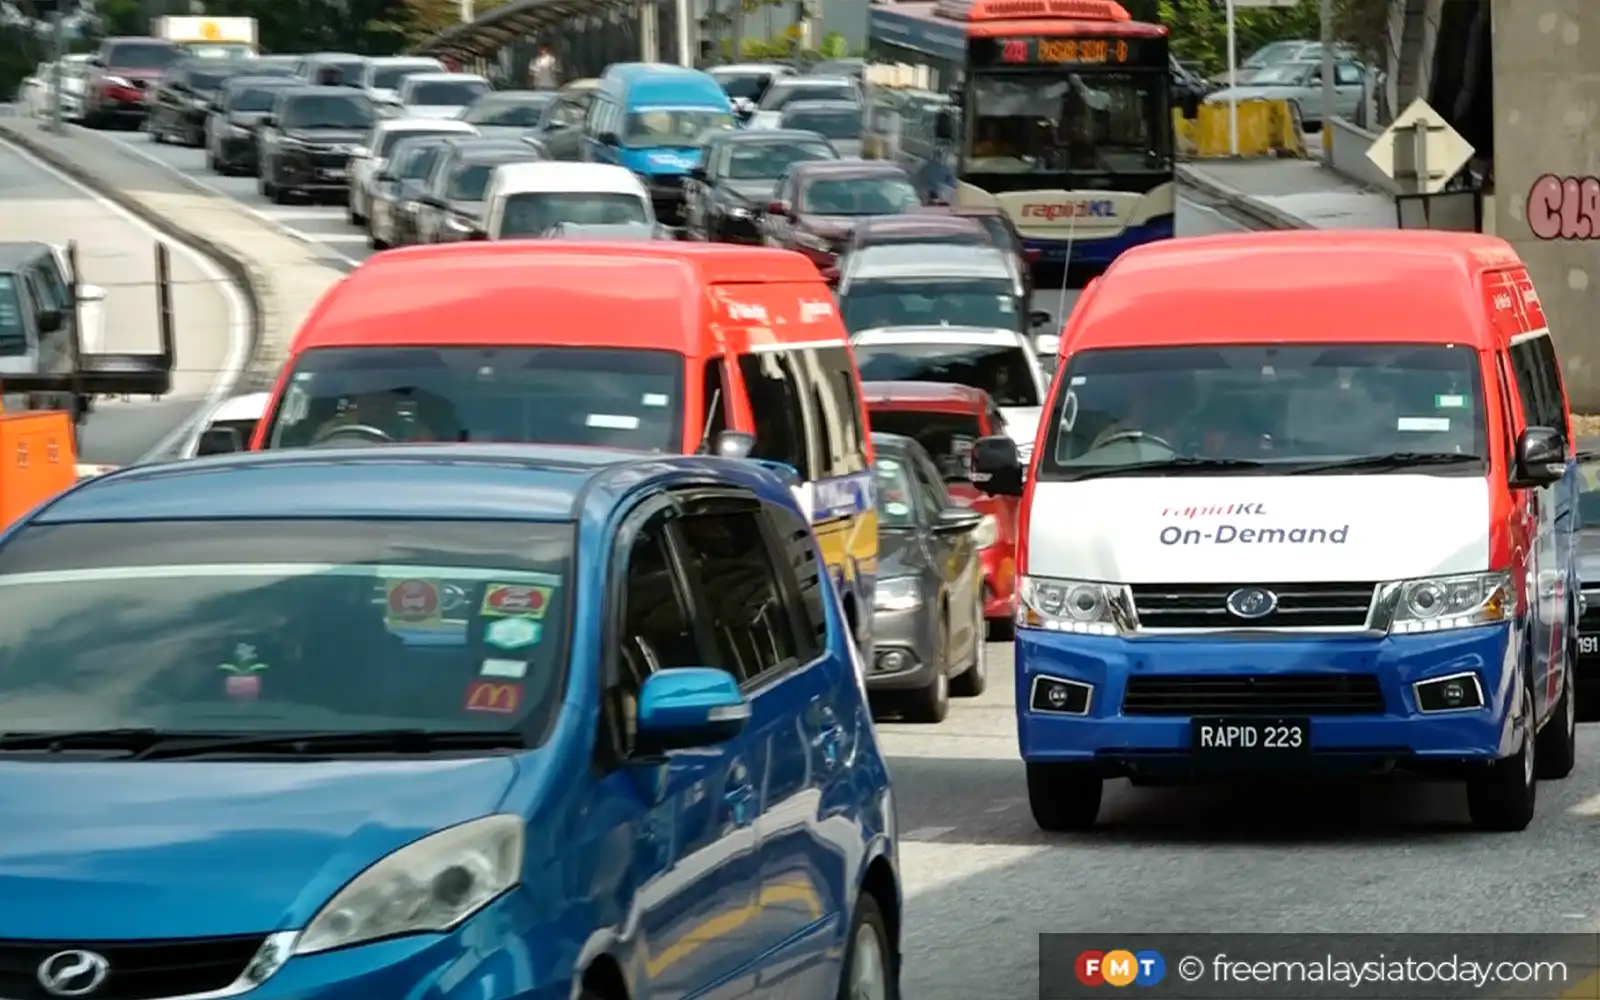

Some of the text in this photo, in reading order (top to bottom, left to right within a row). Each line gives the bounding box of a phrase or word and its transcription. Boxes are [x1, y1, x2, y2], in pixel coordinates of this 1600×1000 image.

[1161, 503, 1267, 519] rapidKL
[1159, 524, 1350, 545] On-Demand
[1200, 725, 1303, 748] RAPID 223
